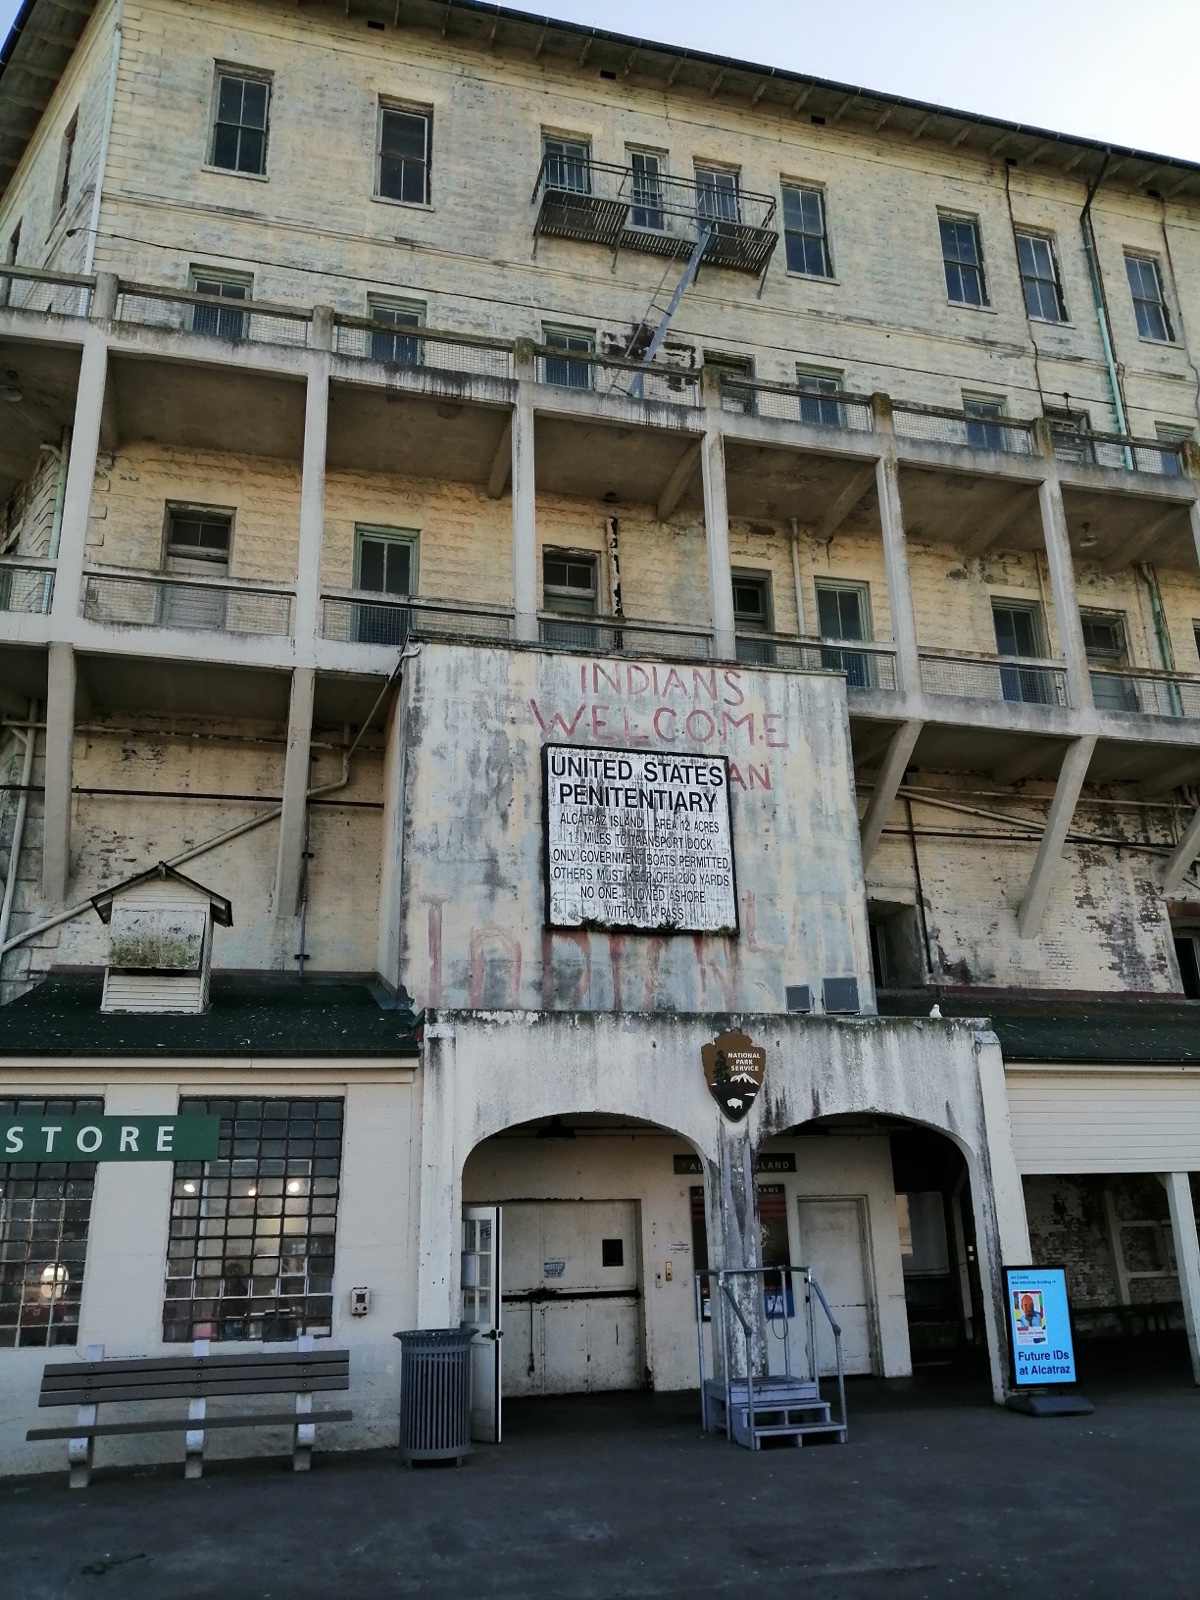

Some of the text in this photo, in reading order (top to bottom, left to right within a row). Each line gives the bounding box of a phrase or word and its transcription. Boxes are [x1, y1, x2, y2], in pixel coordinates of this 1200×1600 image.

[580, 662, 744, 706] INDIANS
[530, 698, 789, 748] WELCOME
[551, 755, 724, 787] UNITED STATES
[559, 783, 717, 813] PENITENTIARY
[560, 812, 720, 834] ALCATRAZ ISLAND AREA 12 ACRES
[584, 832, 612, 846] MILES
[615, 833, 627, 847] TO
[629, 834, 684, 850] TRANSPORT
[688, 837, 713, 851] DOCK
[553, 848, 729, 869] ONLY GOVERNMENT BOATS PERMITTED
[553, 866, 730, 887] OTHERS MUST KEEP OFF 200 YARDS
[580, 886, 595, 899] NO
[598, 886, 618, 900] ONE
[669, 889, 706, 904] ASHORE
[605, 905, 648, 920] WITHOUT
[661, 907, 684, 920] PASS
[5, 1125, 175, 1153] STORE
[1018, 1350, 1070, 1361] Future IDs
[1019, 1365, 1071, 1376] at Alcatraz
